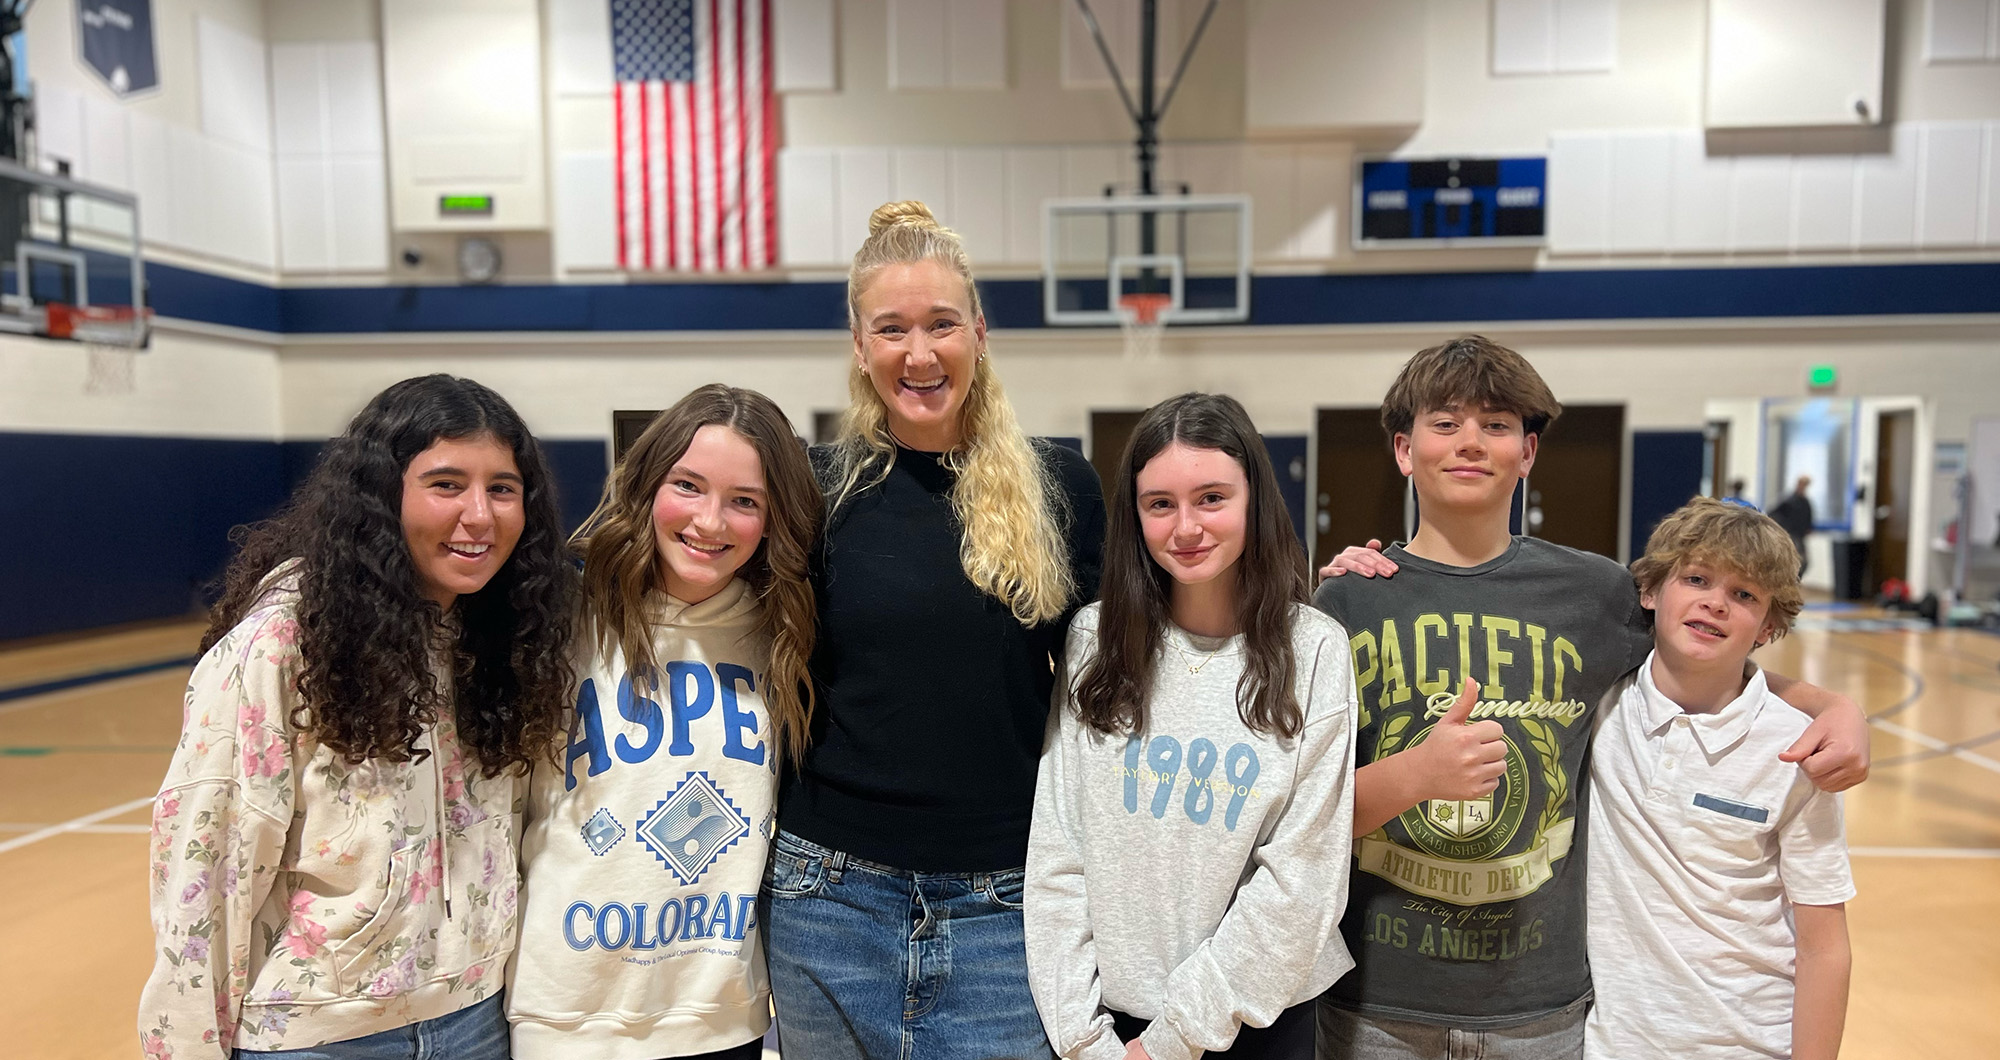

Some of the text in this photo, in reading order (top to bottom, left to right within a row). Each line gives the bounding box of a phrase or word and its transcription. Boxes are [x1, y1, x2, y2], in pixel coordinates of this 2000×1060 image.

[1349, 611, 1583, 731] PACIFIC
[564, 660, 776, 792] ASPE
[1123, 731, 1261, 832] 1989
[1411, 818, 1509, 856] ESTABLISHED 1980
[1381, 850, 1472, 897] ATHLETIC
[1402, 899, 1513, 928] The City Of Angels
[698, 946, 716, 955] Group
[1418, 919, 1544, 961] ANGELES
